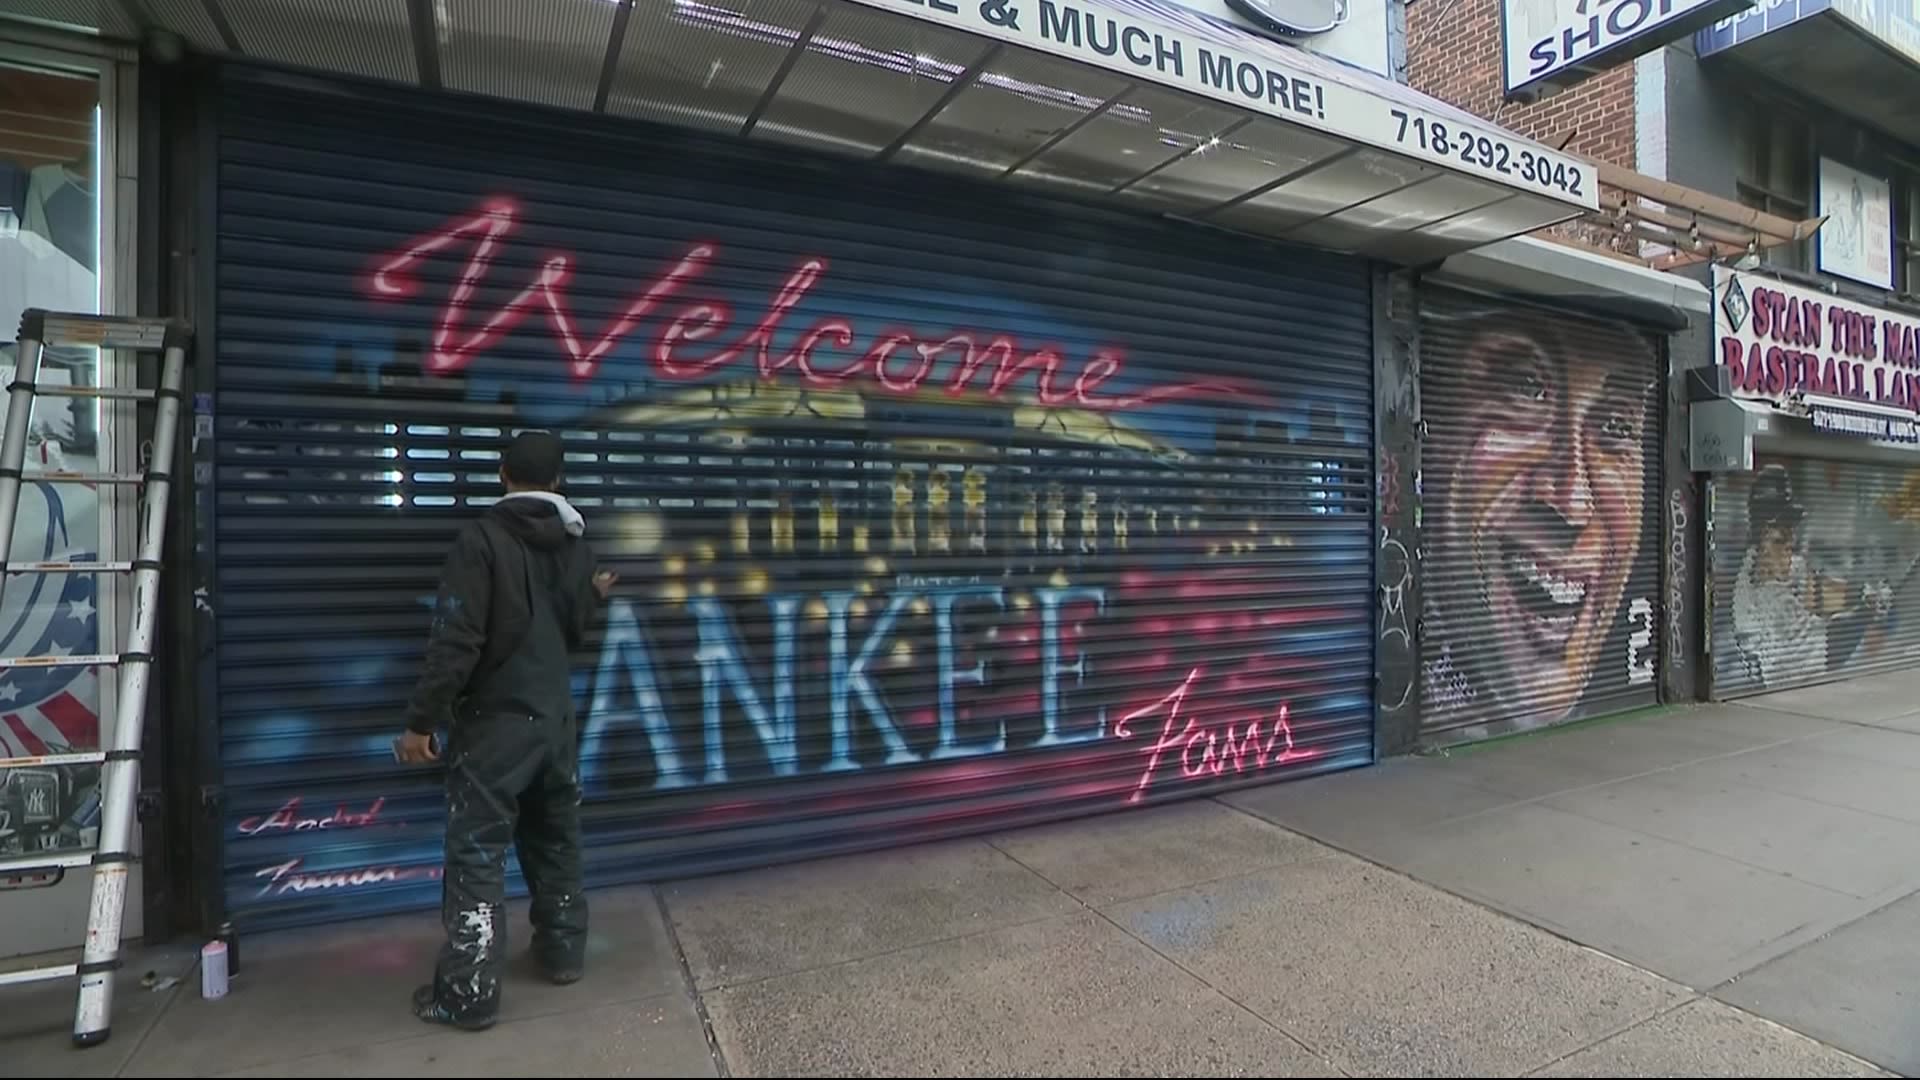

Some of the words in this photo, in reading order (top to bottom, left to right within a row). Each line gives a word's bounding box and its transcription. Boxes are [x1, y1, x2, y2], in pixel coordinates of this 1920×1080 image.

[979, 0, 1020, 31] &
[1039, 0, 1184, 77] MUCH
[1198, 48, 1325, 119] MORE!
[1530, 0, 1672, 75] SHO
[1391, 109, 1583, 196] 718-292-3042
[368, 197, 1272, 412] Welcome
[1752, 286, 1822, 348] STAN
[1828, 306, 1877, 361] THE
[1721, 336, 1870, 400] BASEBALL
[575, 586, 1105, 798] ANKEE
[1115, 668, 1314, 802] Fans
